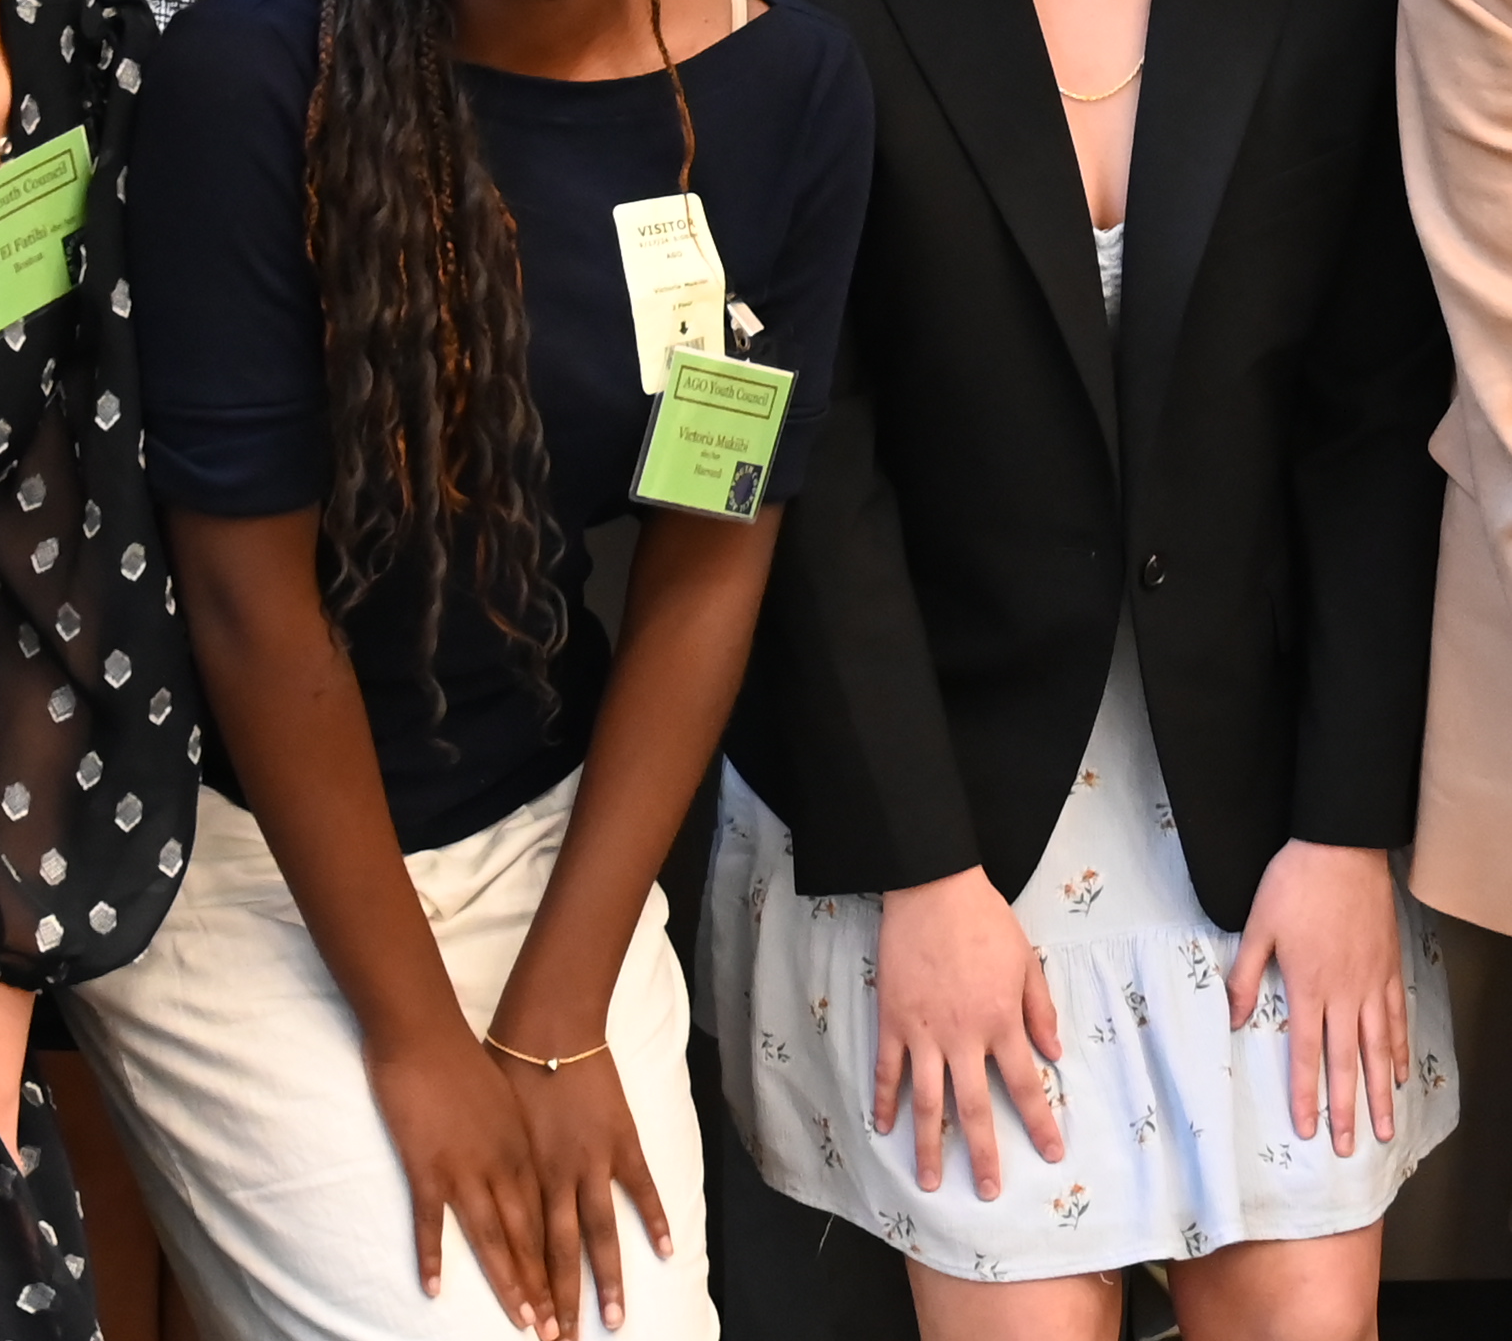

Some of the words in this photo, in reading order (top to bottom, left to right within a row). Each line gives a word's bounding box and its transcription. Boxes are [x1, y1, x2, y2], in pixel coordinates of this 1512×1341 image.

[638, 218, 697, 237] VISITOR
[683, 376, 709, 392] AGO
[708, 381, 735, 400] Youth
[735, 388, 770, 407] Council
